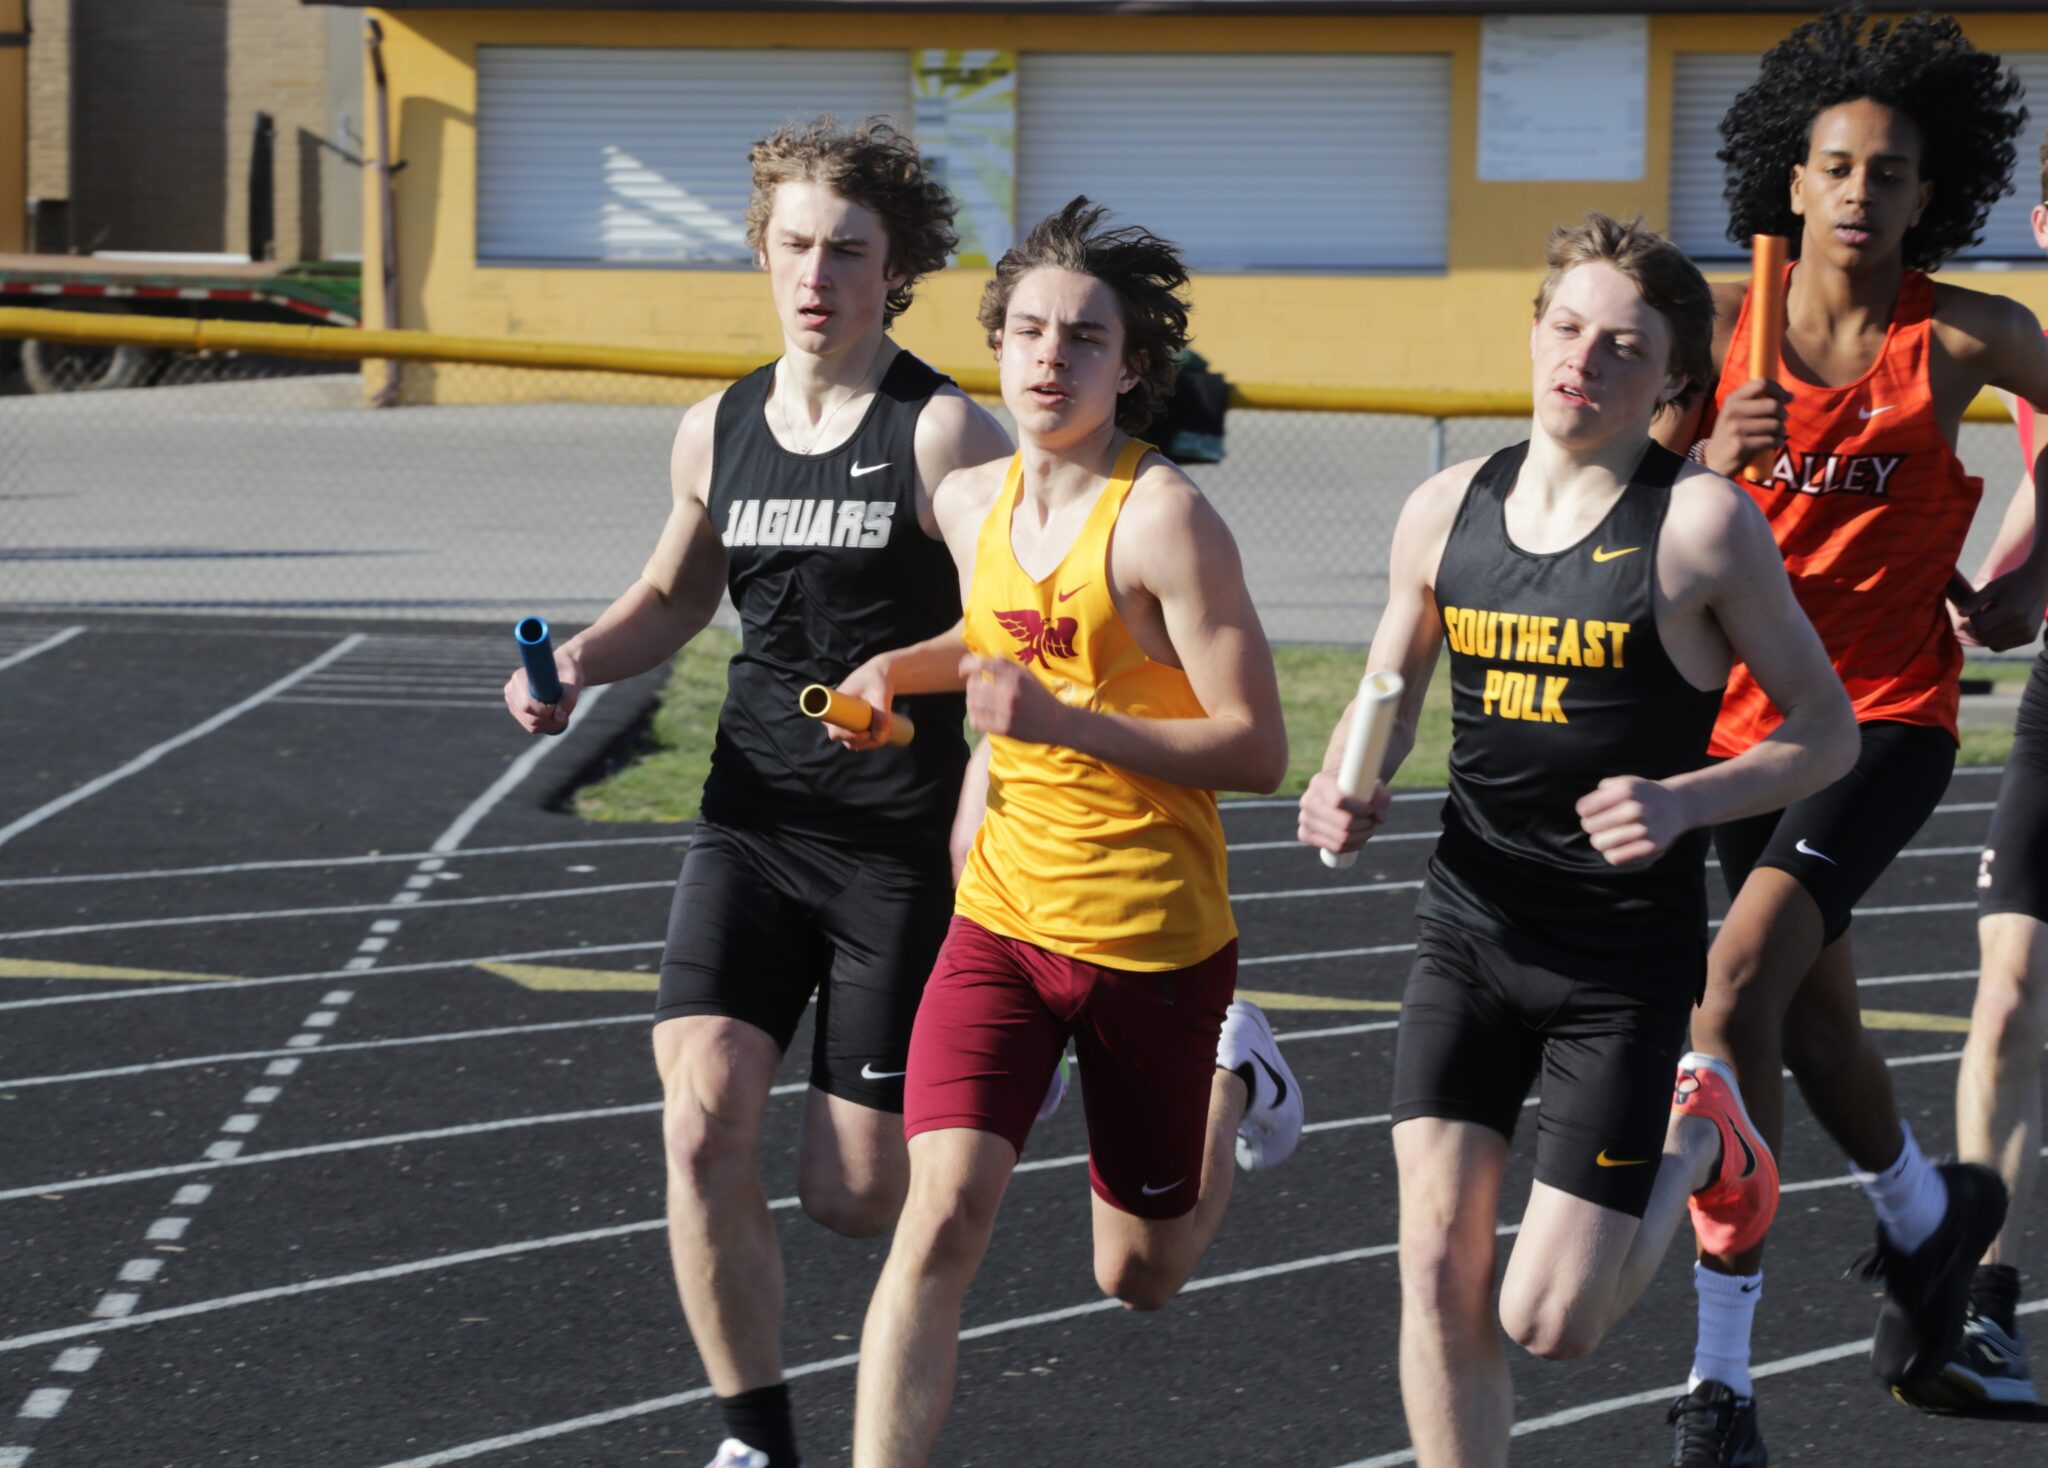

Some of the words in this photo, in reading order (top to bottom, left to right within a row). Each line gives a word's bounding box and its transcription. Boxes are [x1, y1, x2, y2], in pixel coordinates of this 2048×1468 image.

[1749, 447, 1904, 496] ALLEY
[721, 499, 897, 549] JAGUARS
[1444, 605, 1631, 669] SOUTHEAST
[1482, 669, 1570, 724] POLK
